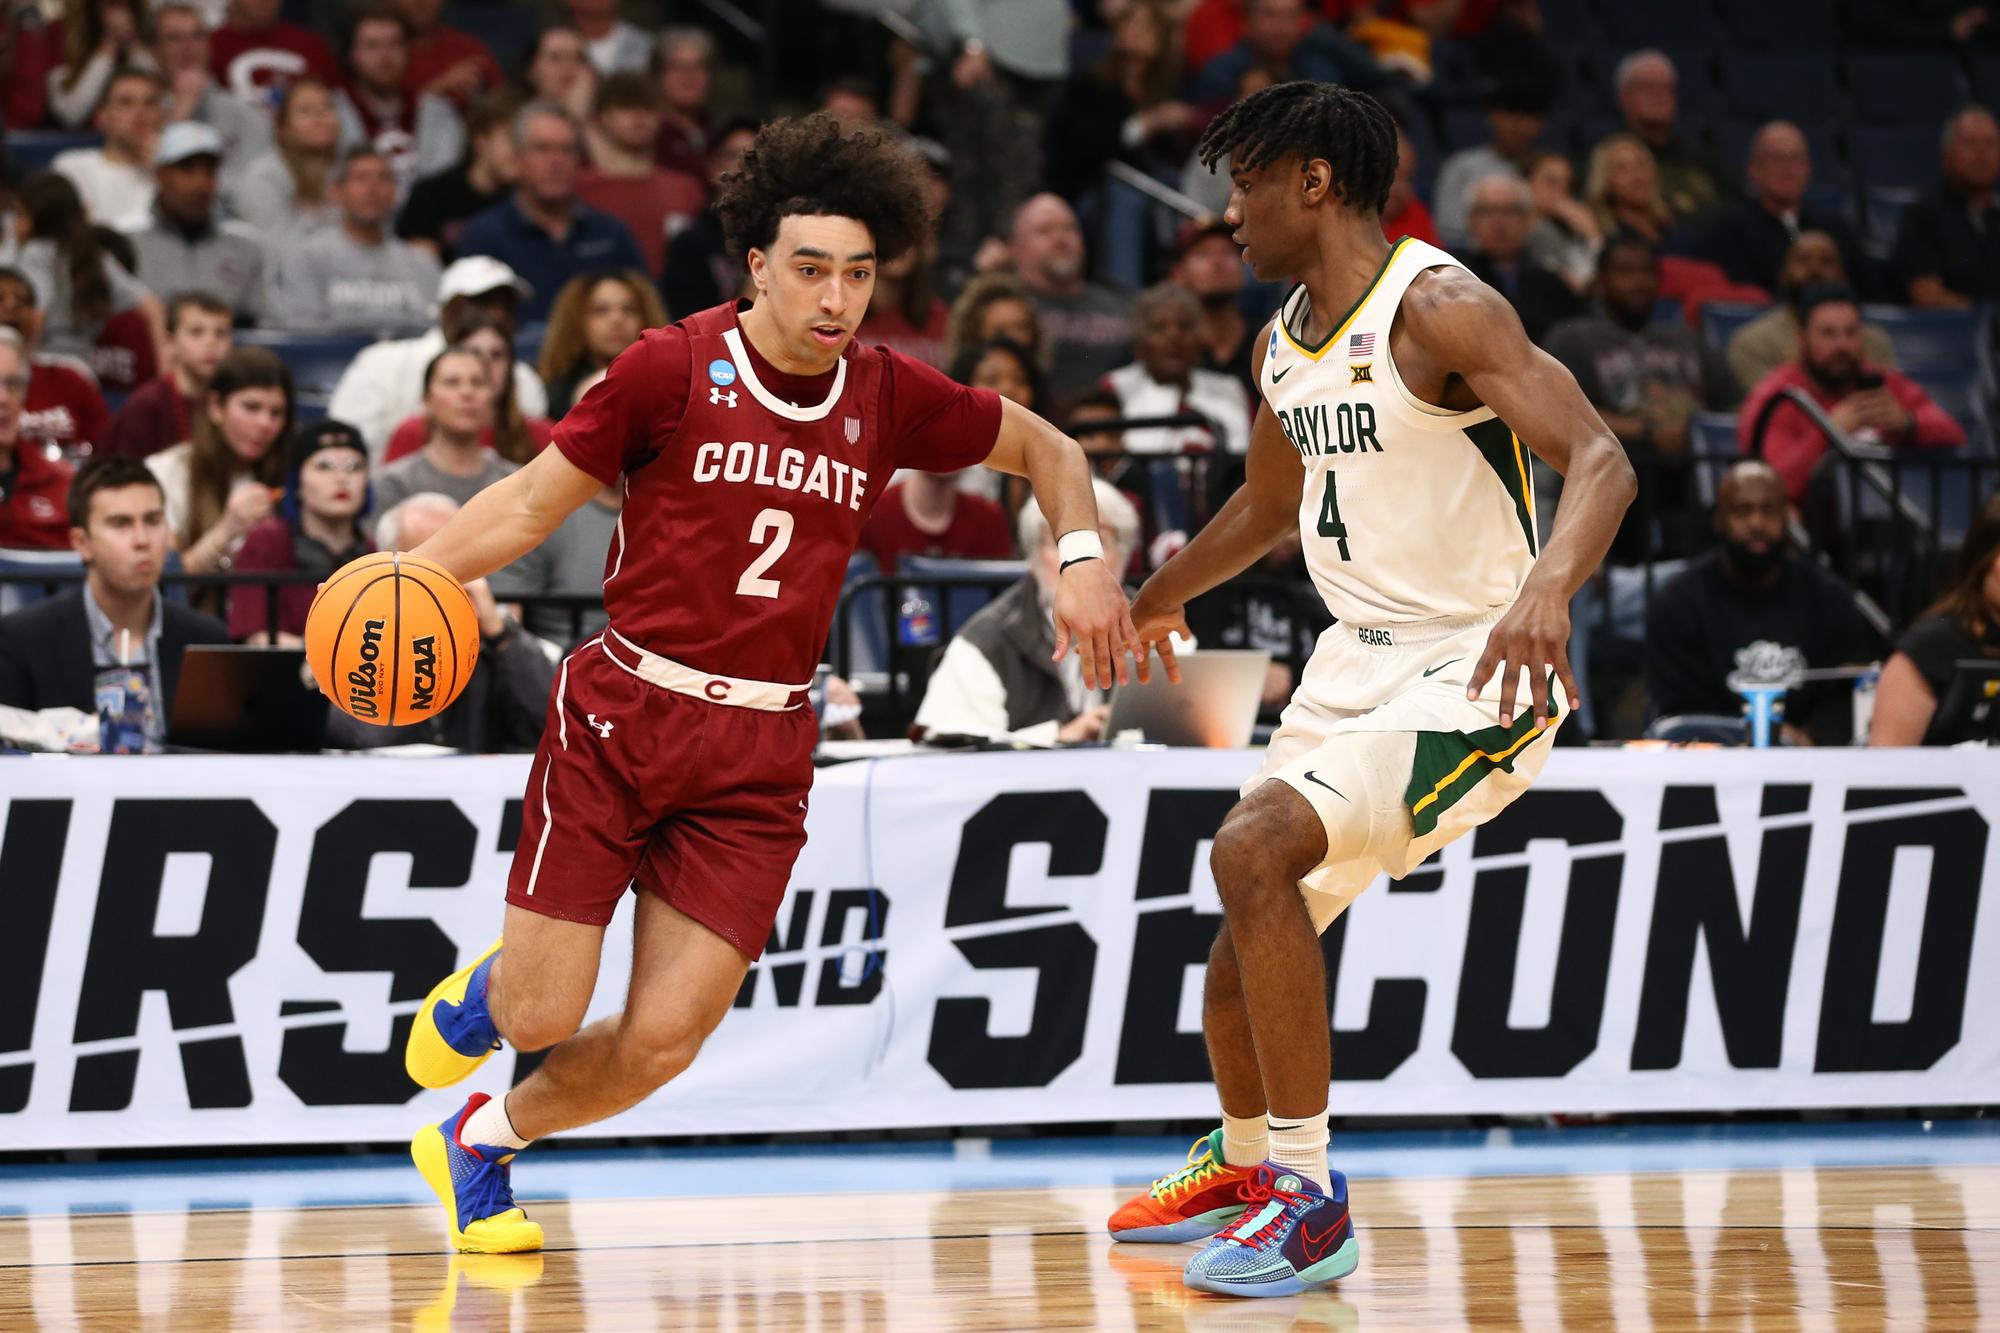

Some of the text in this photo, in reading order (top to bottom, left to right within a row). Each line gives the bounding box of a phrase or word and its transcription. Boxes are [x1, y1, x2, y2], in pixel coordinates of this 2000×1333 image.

[693, 441, 867, 512] COLGATE
[1316, 470, 1352, 561] 4
[735, 508, 795, 599] 2
[348, 619, 386, 718] Wilson
[410, 635, 436, 711] NCAA
[1358, 627, 1393, 646] BEARS
[704, 680, 732, 701] C
[0, 782, 1989, 1114] IRS ND SECOND
